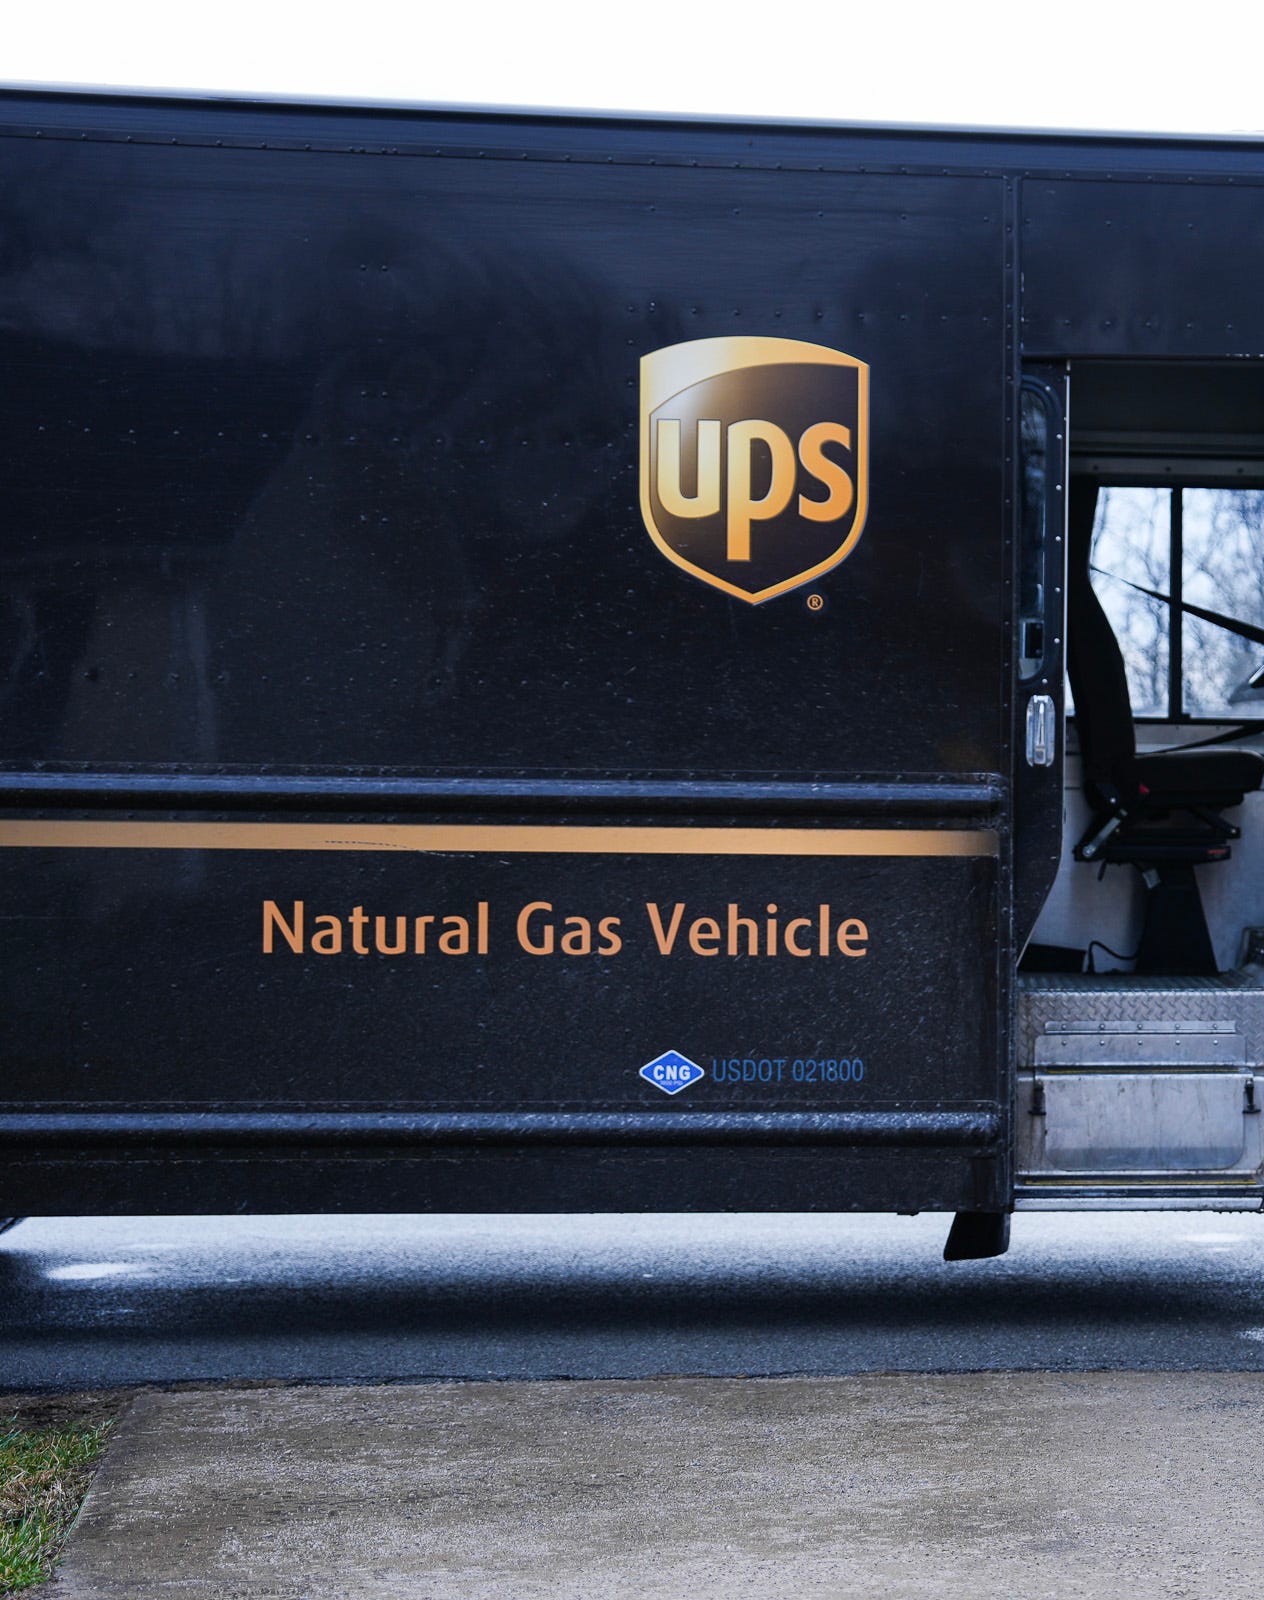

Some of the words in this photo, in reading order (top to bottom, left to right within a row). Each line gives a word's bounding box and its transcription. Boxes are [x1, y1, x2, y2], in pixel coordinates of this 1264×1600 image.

[656, 419, 854, 562] ups
[262, 900, 489, 955] Natural
[516, 901, 623, 956] Gas
[646, 902, 870, 957] Vehicle
[653, 1064, 691, 1081] CNG
[712, 1059, 787, 1082] USDOT
[792, 1058, 865, 1082] 021800
